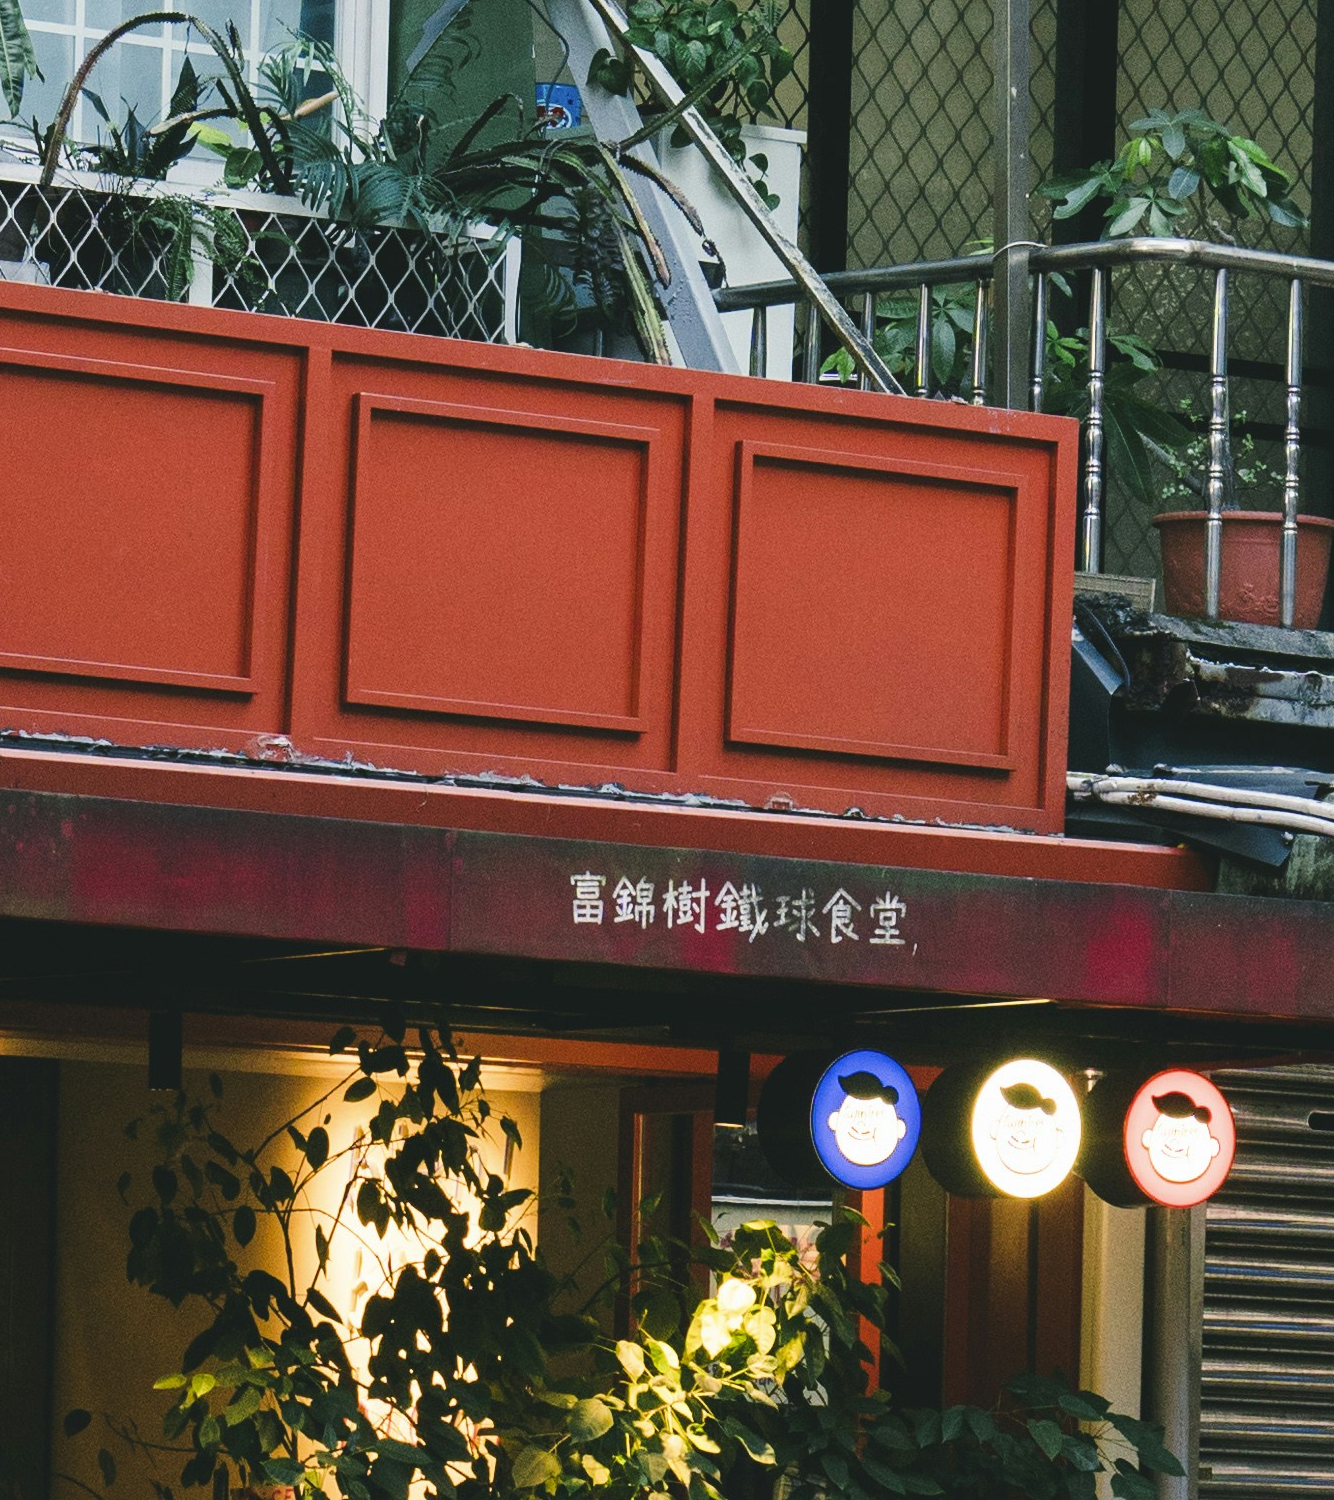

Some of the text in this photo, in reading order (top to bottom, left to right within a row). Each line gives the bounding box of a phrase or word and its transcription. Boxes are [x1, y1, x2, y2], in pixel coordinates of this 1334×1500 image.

[569, 870, 907, 945] 富錦樹鐵球食堂
